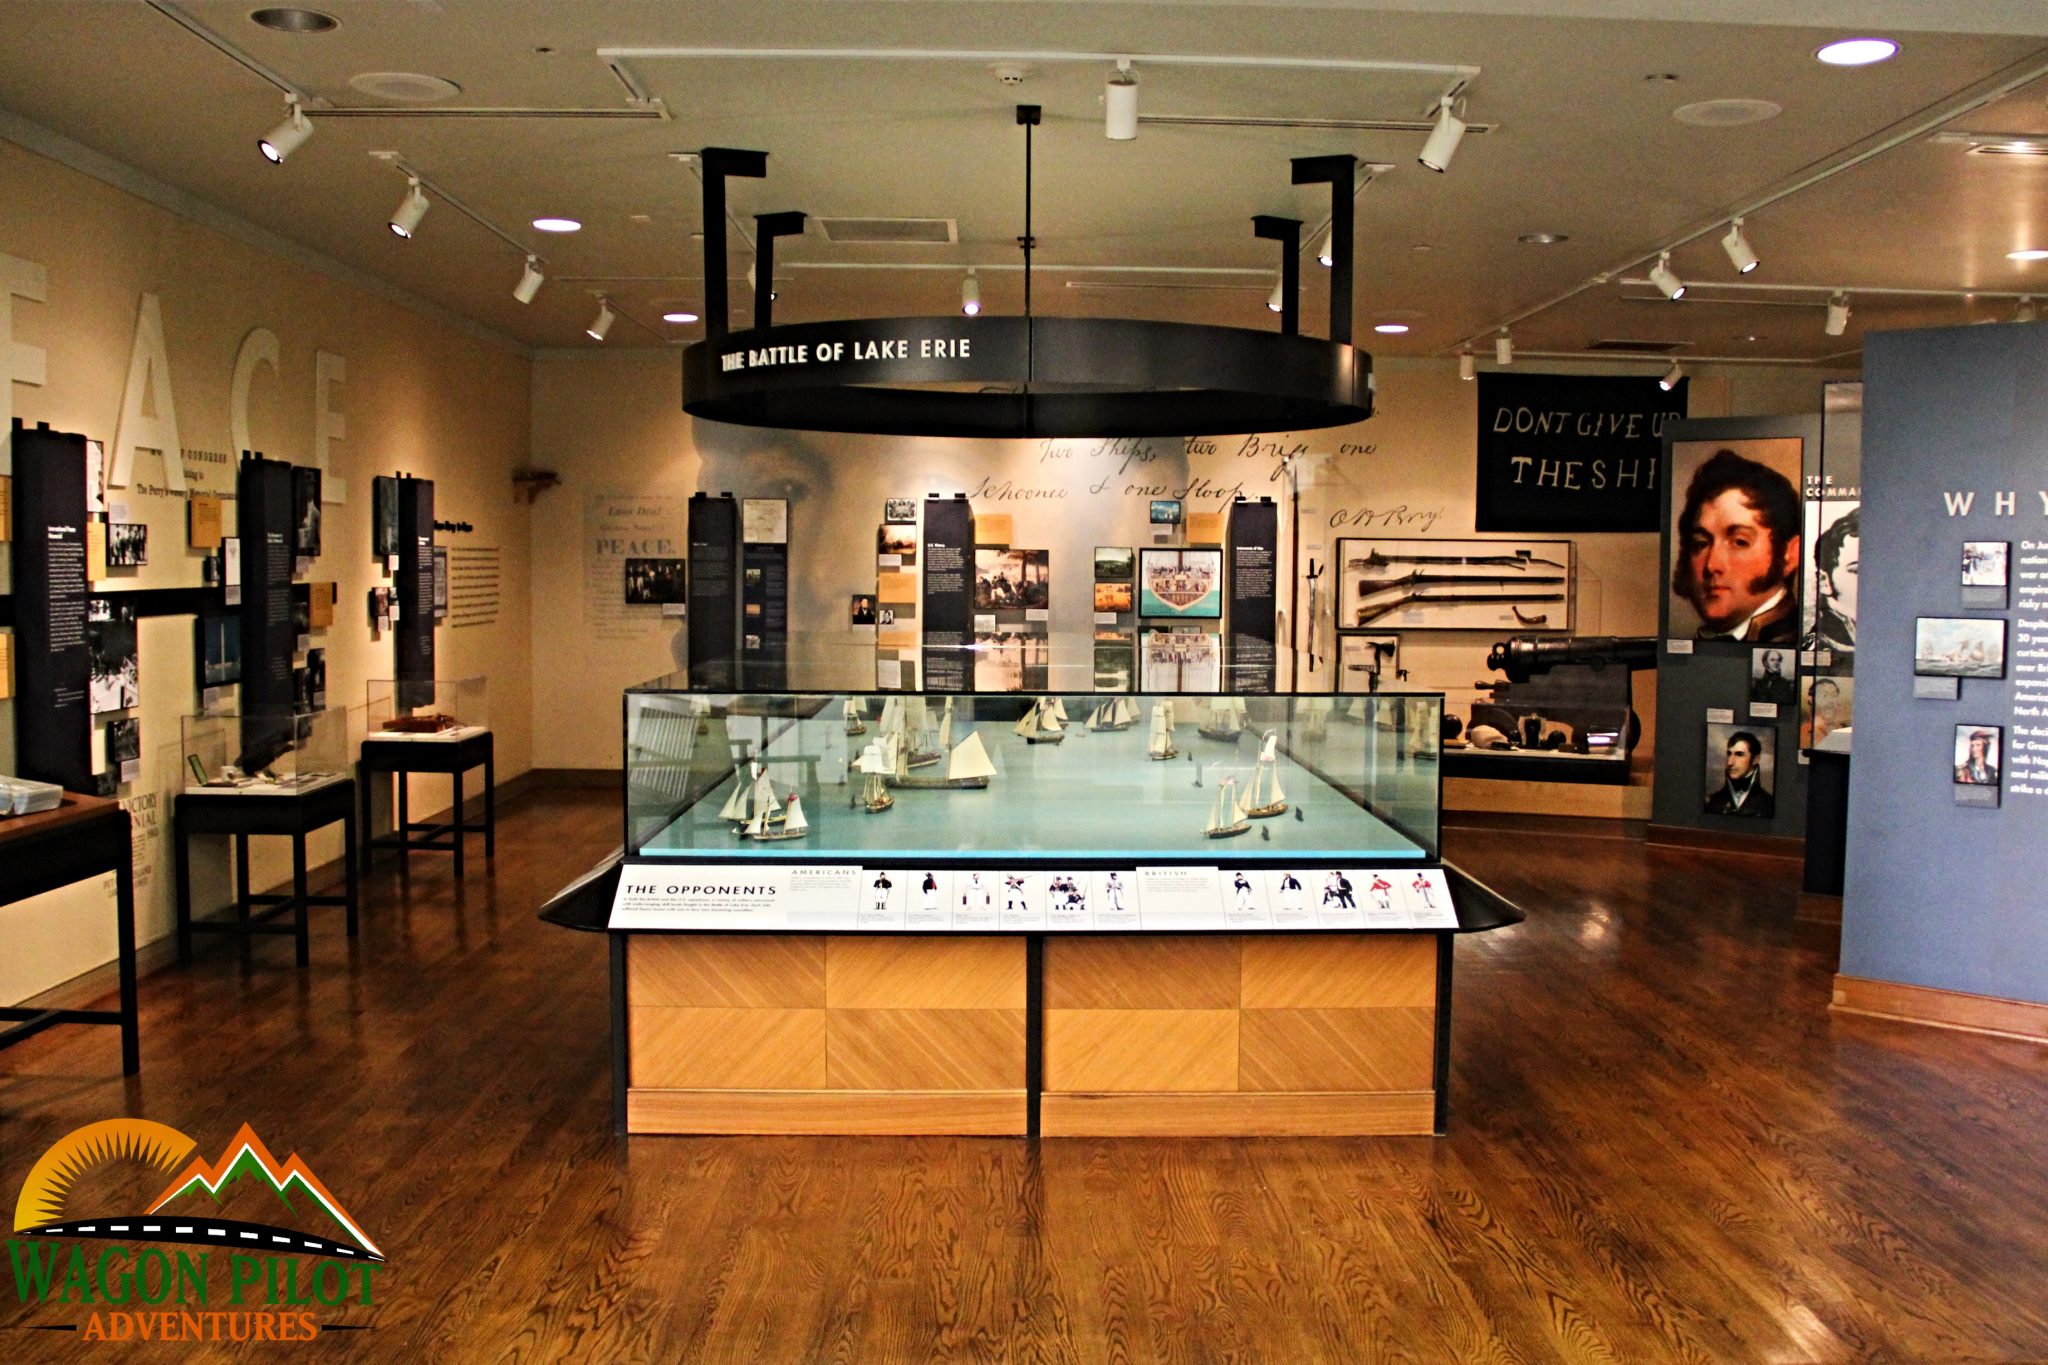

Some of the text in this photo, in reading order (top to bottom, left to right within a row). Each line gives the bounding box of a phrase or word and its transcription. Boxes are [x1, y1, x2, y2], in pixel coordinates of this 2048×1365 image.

[721, 338, 971, 372] THE BATTLE OF LAKE ERIE
[1493, 406, 1572, 436] DONT
[1577, 412, 1644, 439] GIVE
[1184, 436, 1217, 455] two
[1339, 442, 1377, 456] one
[1511, 456, 1583, 490] THE
[1806, 475, 1833, 485] THE
[1124, 484, 1167, 497] one
[2021, 540, 2036, 550] On
[2018, 599, 2041, 611] risky
[2017, 633, 2030, 643] 30
[2015, 664, 2036, 672] over
[2014, 706, 2040, 716] North
[2013, 725, 2029, 735] The
[2012, 739, 2026, 750] for
[2011, 755, 2031, 764] with
[2010, 769, 2029, 779] and
[2010, 784, 2034, 794] strike
[626, 885, 777, 895] THE OPPONENTS
